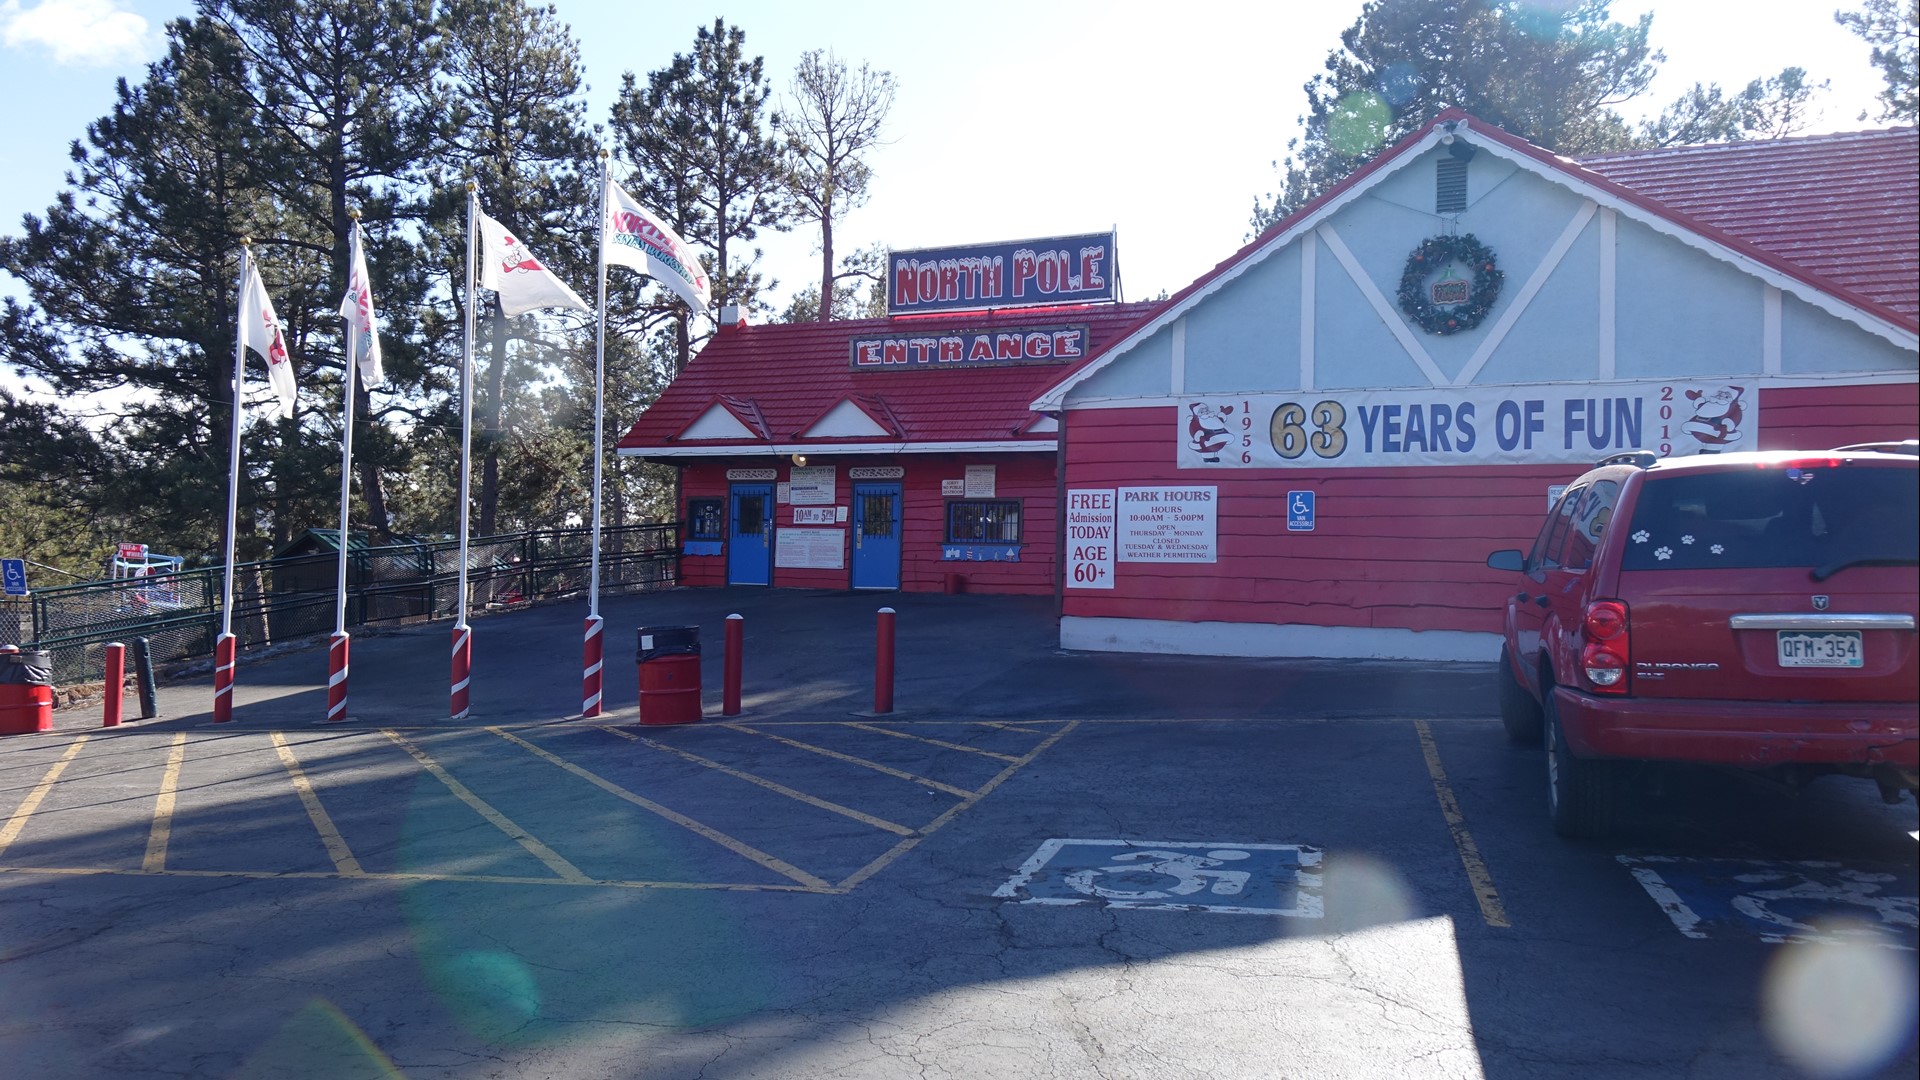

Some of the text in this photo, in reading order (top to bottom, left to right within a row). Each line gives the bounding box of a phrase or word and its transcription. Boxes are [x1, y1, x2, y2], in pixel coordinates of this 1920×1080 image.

[896, 246, 1104, 305] NORTH POLE
[857, 331, 1081, 366] ENTRANCE
[1270, 397, 1643, 459] 63 YEARS OF FUN
[1071, 494, 1111, 509] FREE
[1124, 491, 1211, 502] PARK HOURS
[1069, 512, 1112, 523] Admission
[1070, 526, 1111, 539] TODAY
[1073, 546, 1107, 560] AGE
[1074, 563, 1106, 582] 60+
